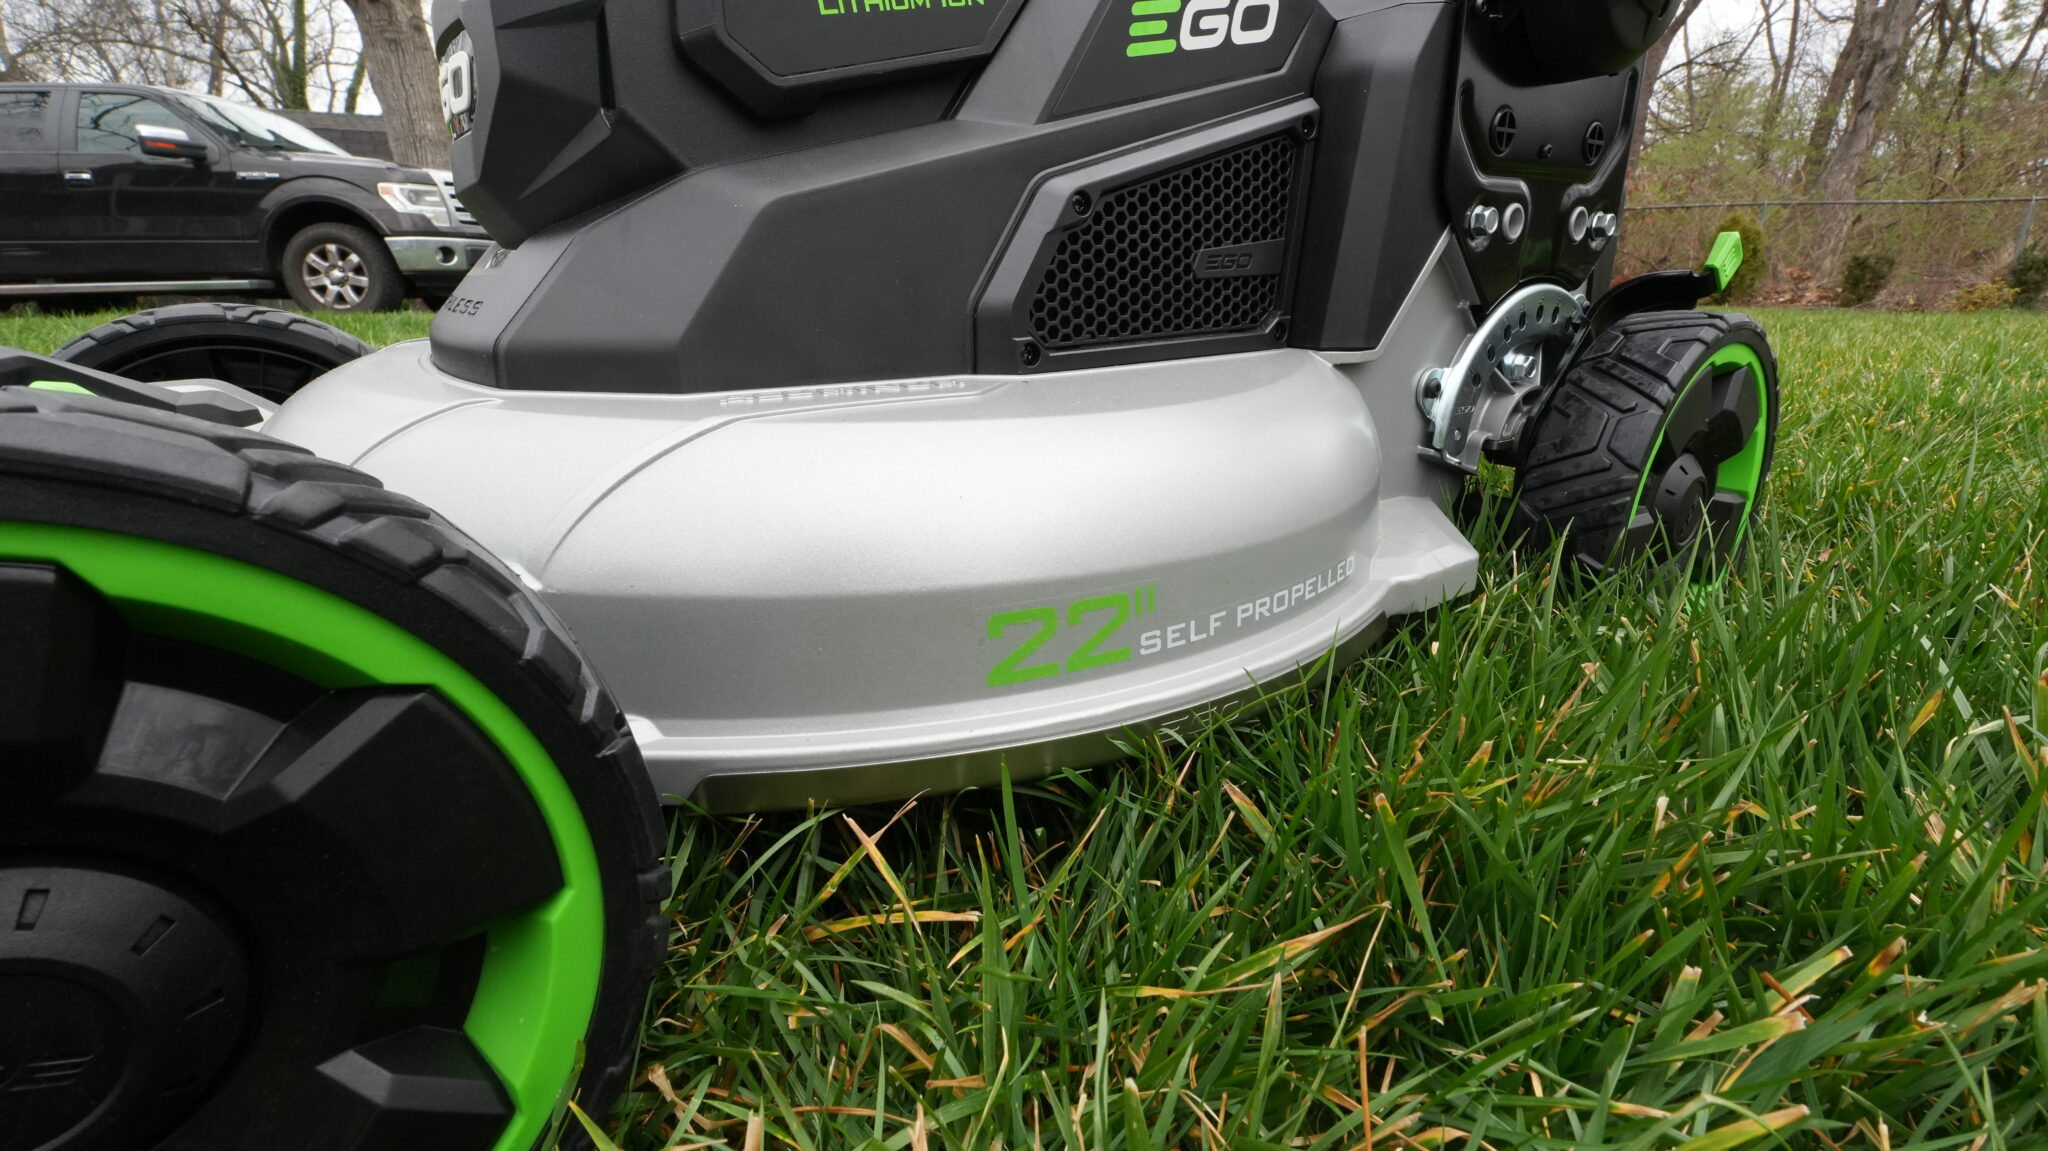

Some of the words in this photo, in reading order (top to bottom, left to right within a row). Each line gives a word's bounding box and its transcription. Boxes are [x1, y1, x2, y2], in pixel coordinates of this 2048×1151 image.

[1126, 0, 1280, 58] EGO
[437, 50, 471, 126] GO
[1202, 252, 1253, 272] EGO
[986, 583, 1157, 688] 22"
[1139, 610, 1226, 656] SELF
[1236, 558, 1356, 628] PROPELLED
